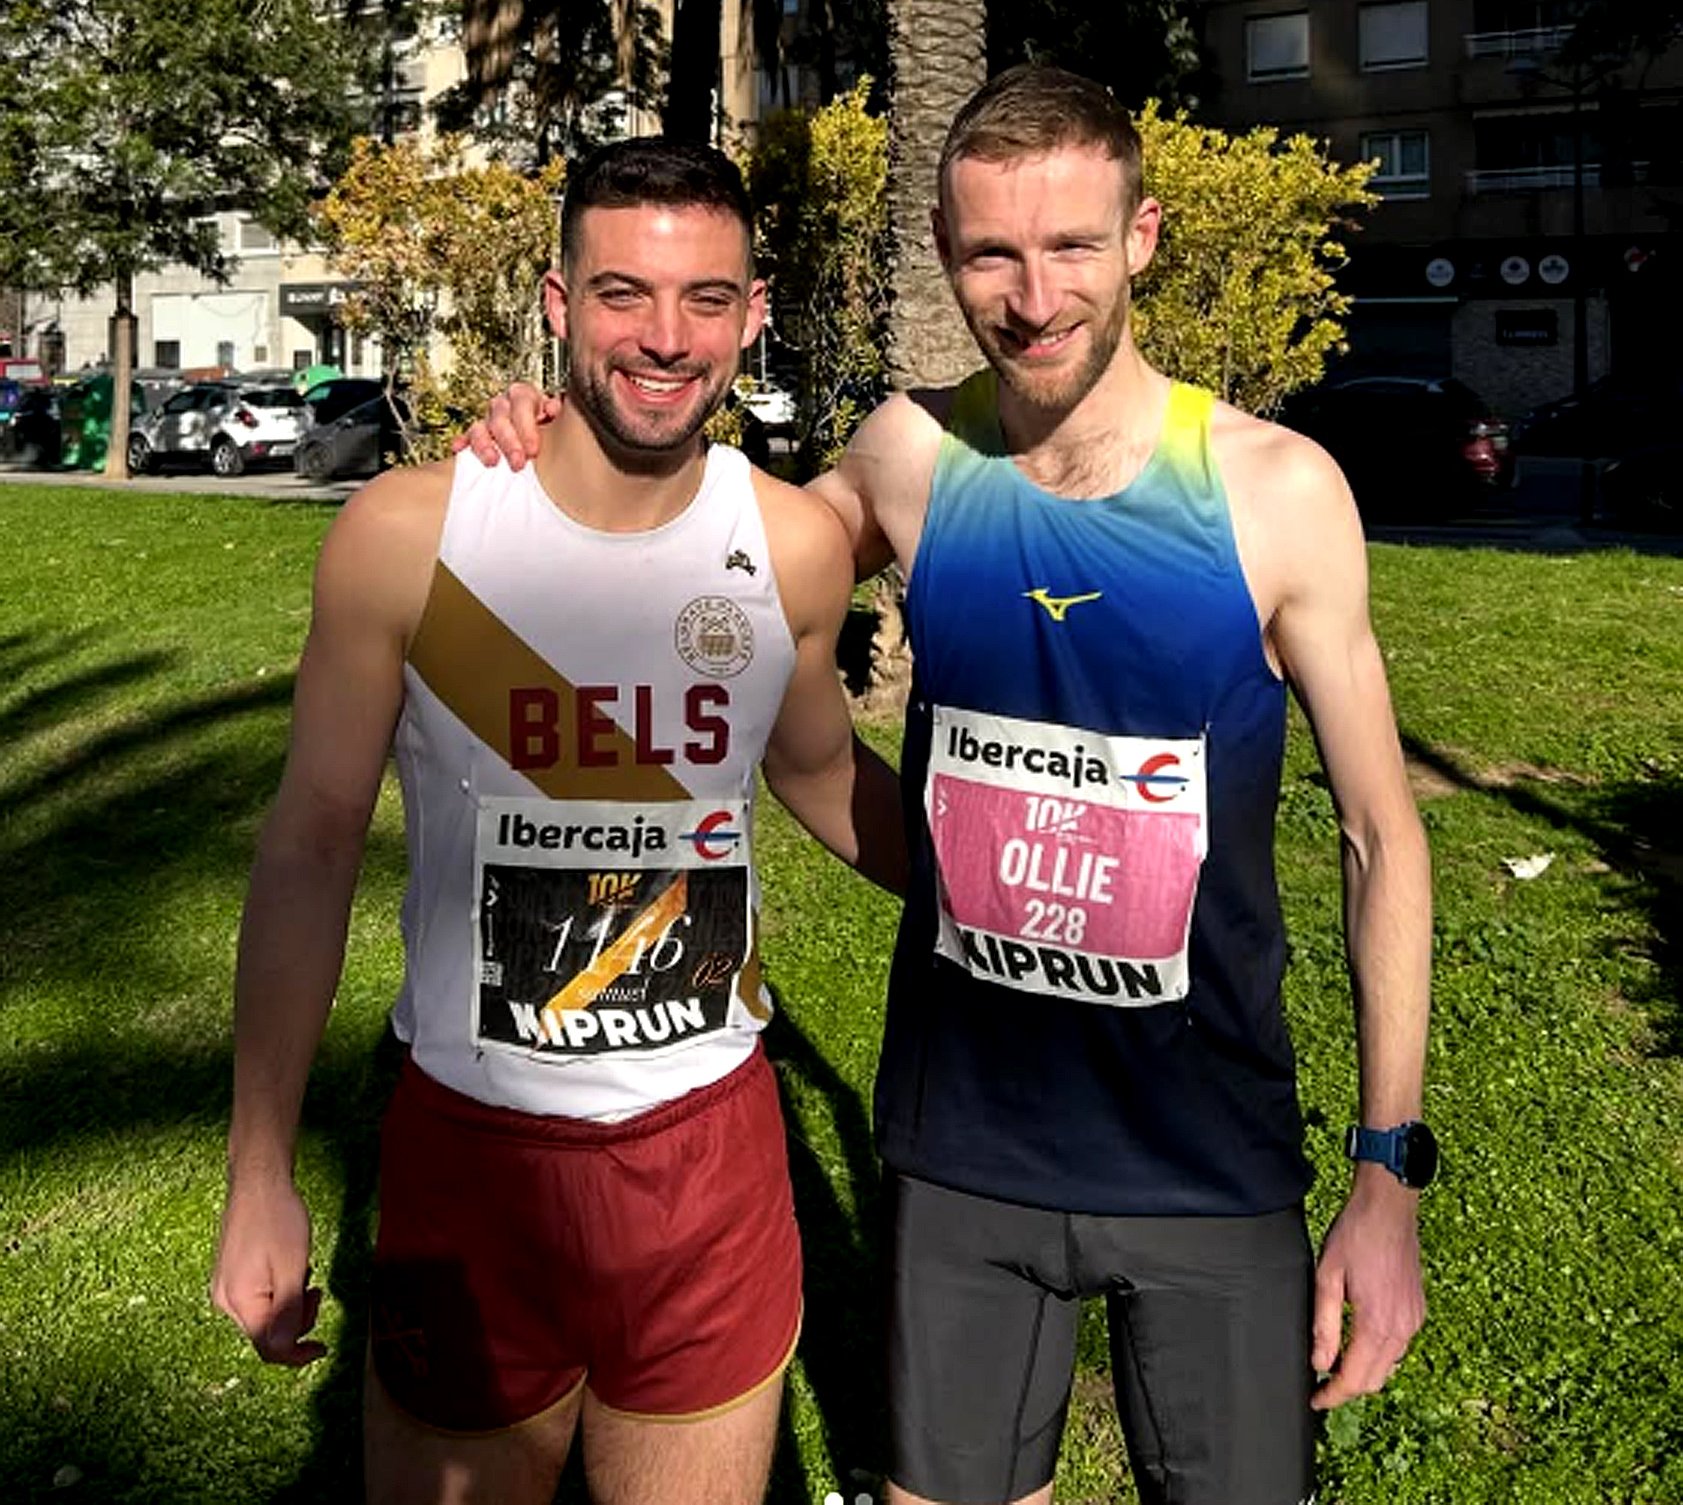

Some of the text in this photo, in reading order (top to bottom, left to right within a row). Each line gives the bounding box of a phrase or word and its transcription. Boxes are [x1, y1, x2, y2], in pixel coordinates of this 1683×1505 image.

[509, 684, 730, 766] BELS
[948, 726, 1109, 788] Ibercaja
[498, 814, 667, 858] Ibercaja
[1024, 796, 1086, 834] 10K
[1001, 838, 1120, 904] OLLIE
[1020, 899, 1087, 945] 228
